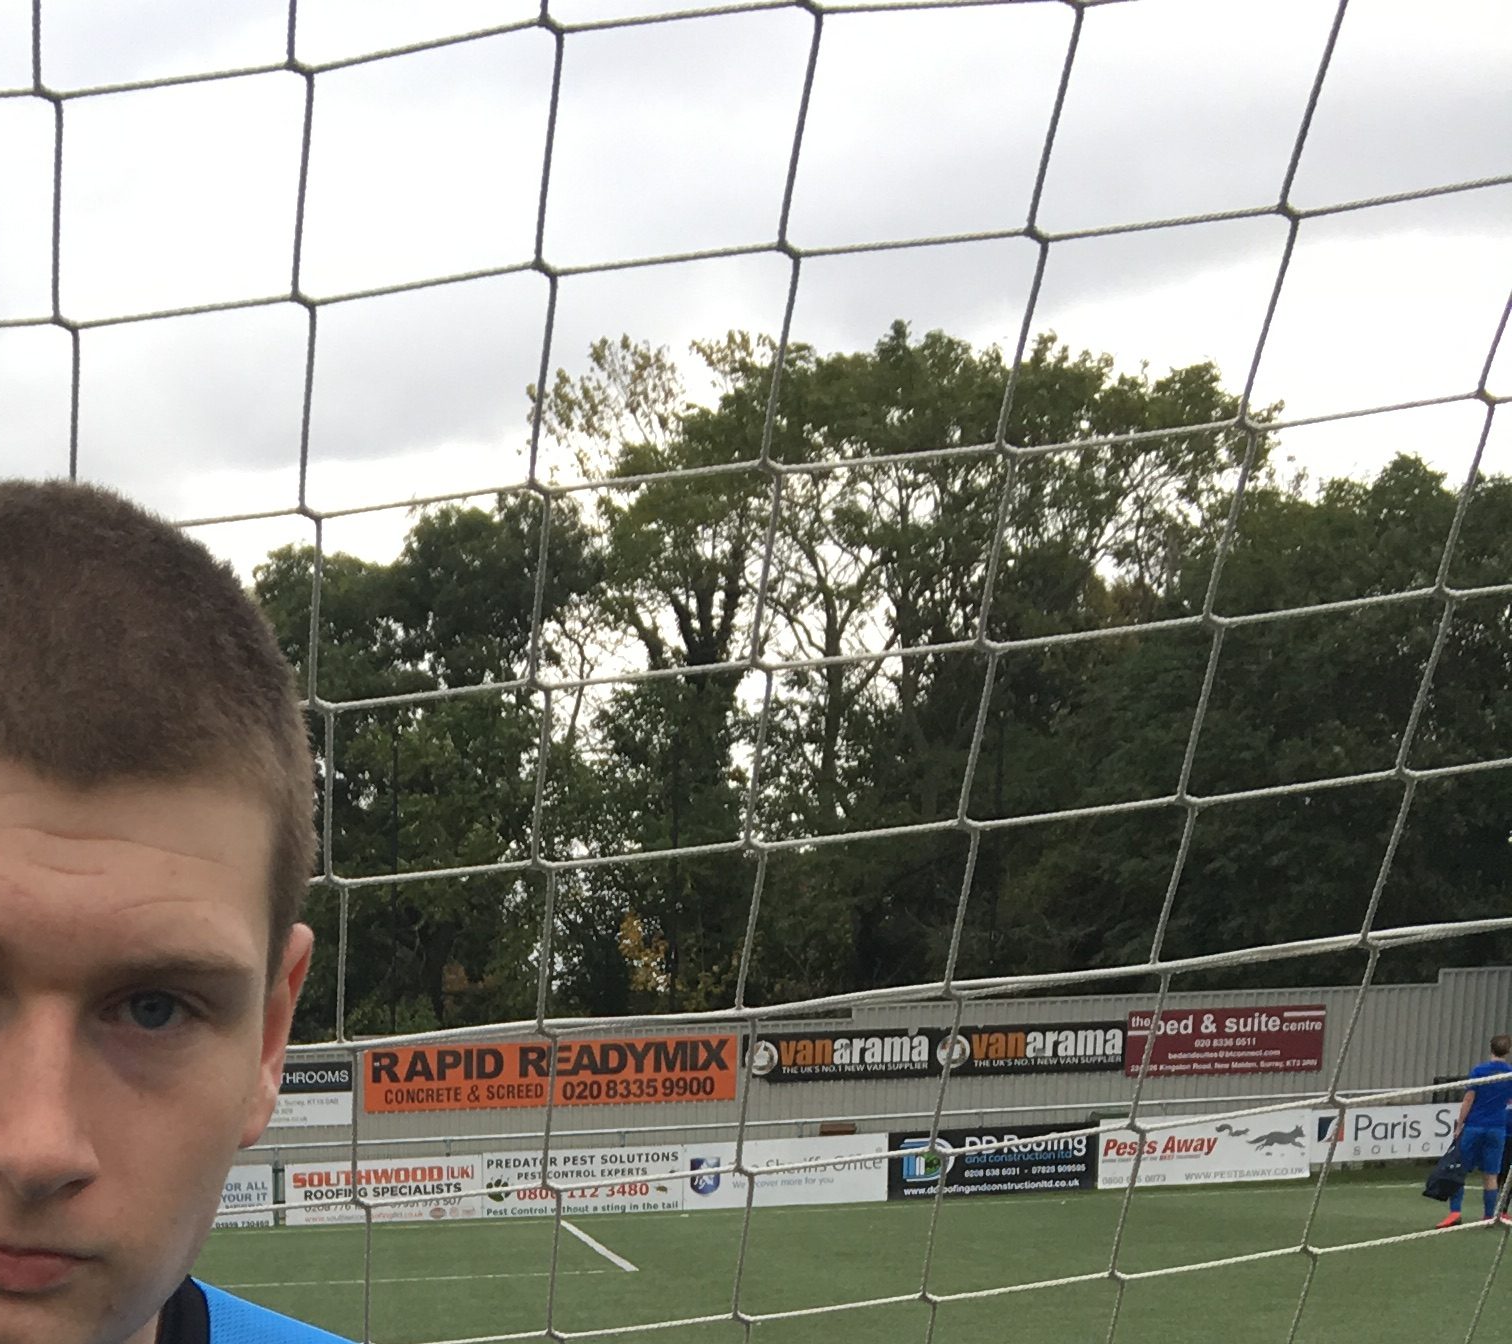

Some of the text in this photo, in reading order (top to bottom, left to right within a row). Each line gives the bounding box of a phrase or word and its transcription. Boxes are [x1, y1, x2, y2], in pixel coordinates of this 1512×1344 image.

[1131, 1016, 1151, 1028] the
[1201, 1014, 1217, 1033] &
[1225, 1012, 1281, 1033] suite
[1283, 1019, 1323, 1032] centre
[780, 1034, 930, 1066] vanarama
[972, 1028, 1123, 1060] vanarama
[372, 1039, 729, 1083] RAPID READYMIX
[782, 1066, 799, 1074] THE
[845, 1064, 864, 1072] NEW
[867, 1063, 886, 1071] VAN
[888, 1061, 928, 1070] SUPPLIER
[974, 1059, 989, 1067] THE
[1038, 1057, 1057, 1065] NEW
[1059, 1056, 1078, 1065] VAN
[1081, 1054, 1121, 1064] SUPPLIER
[281, 1070, 348, 1084] THROOMS
[384, 1080, 544, 1105] CONCRETE & SCREED
[562, 1076, 715, 1100] 020 8335 9900
[1354, 1114, 1421, 1142] Paris
[1003, 1132, 1087, 1156] Roofing
[1161, 1135, 1218, 1156] Away
[1353, 1142, 1445, 1156] SOLICI
[486, 1151, 679, 1169] PREDATR PEST SOLUTIONS
[965, 1149, 1073, 1164] and construction ltd
[292, 1166, 443, 1189] SOUTHWOOD
[517, 1167, 648, 1180] PEST CONTROL EXPERTS
[225, 1181, 268, 1191] OR ALL
[372, 1182, 462, 1197] SPECIALISTS
[606, 1182, 649, 1197] 3480
[903, 1178, 1080, 1196] www.ddoofingandconstructionltd.co.uk
[221, 1191, 268, 1203] YOUR IT
[487, 1207, 508, 1216] Pest
[510, 1204, 548, 1215] Control
[550, 1203, 589, 1214] wthout
[601, 1201, 627, 1213] sting
[630, 1201, 639, 1211] in
[642, 1201, 659, 1210] the
[661, 1199, 679, 1209] tail
